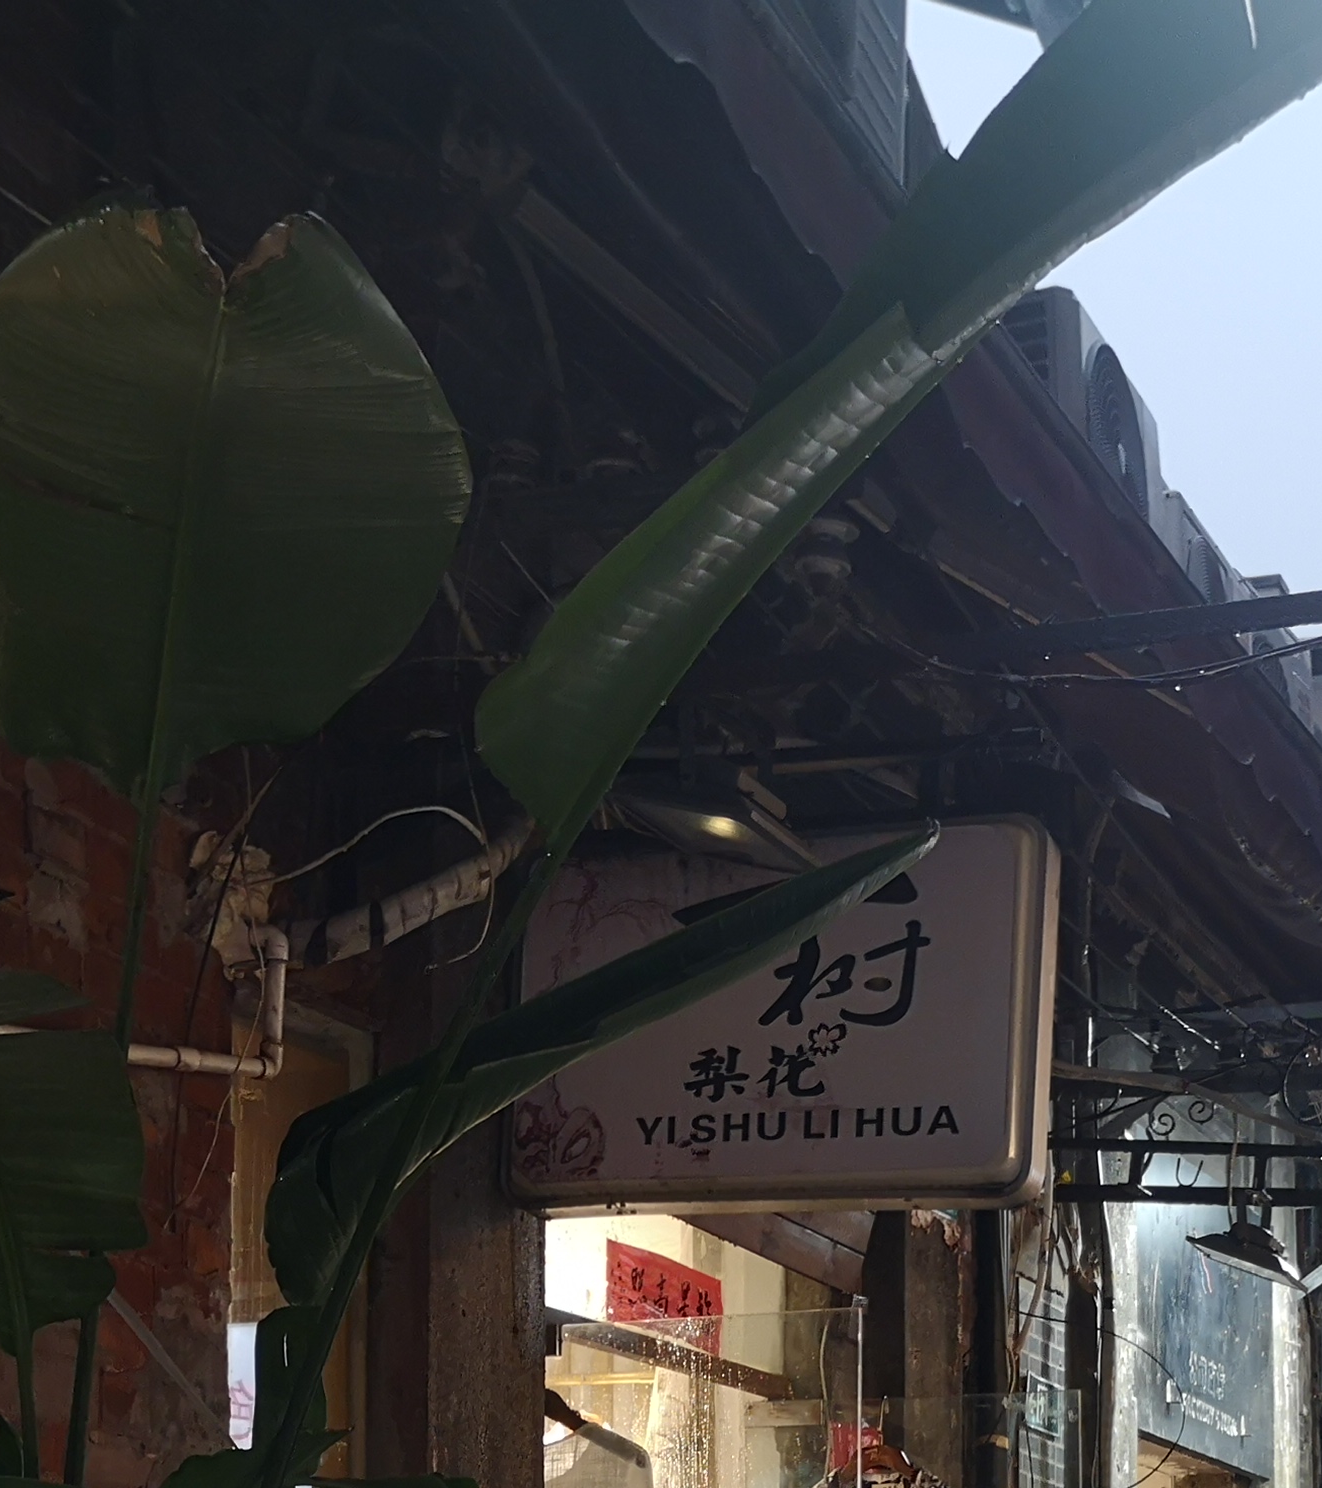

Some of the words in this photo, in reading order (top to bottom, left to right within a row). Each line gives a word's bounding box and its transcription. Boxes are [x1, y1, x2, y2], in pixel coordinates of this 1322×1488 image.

[684, 1046, 825, 1101] 梨花
[637, 1116, 676, 1147] YI
[690, 1110, 786, 1145] SHU
[803, 1109, 841, 1140] LI
[855, 1105, 960, 1137] HUA
